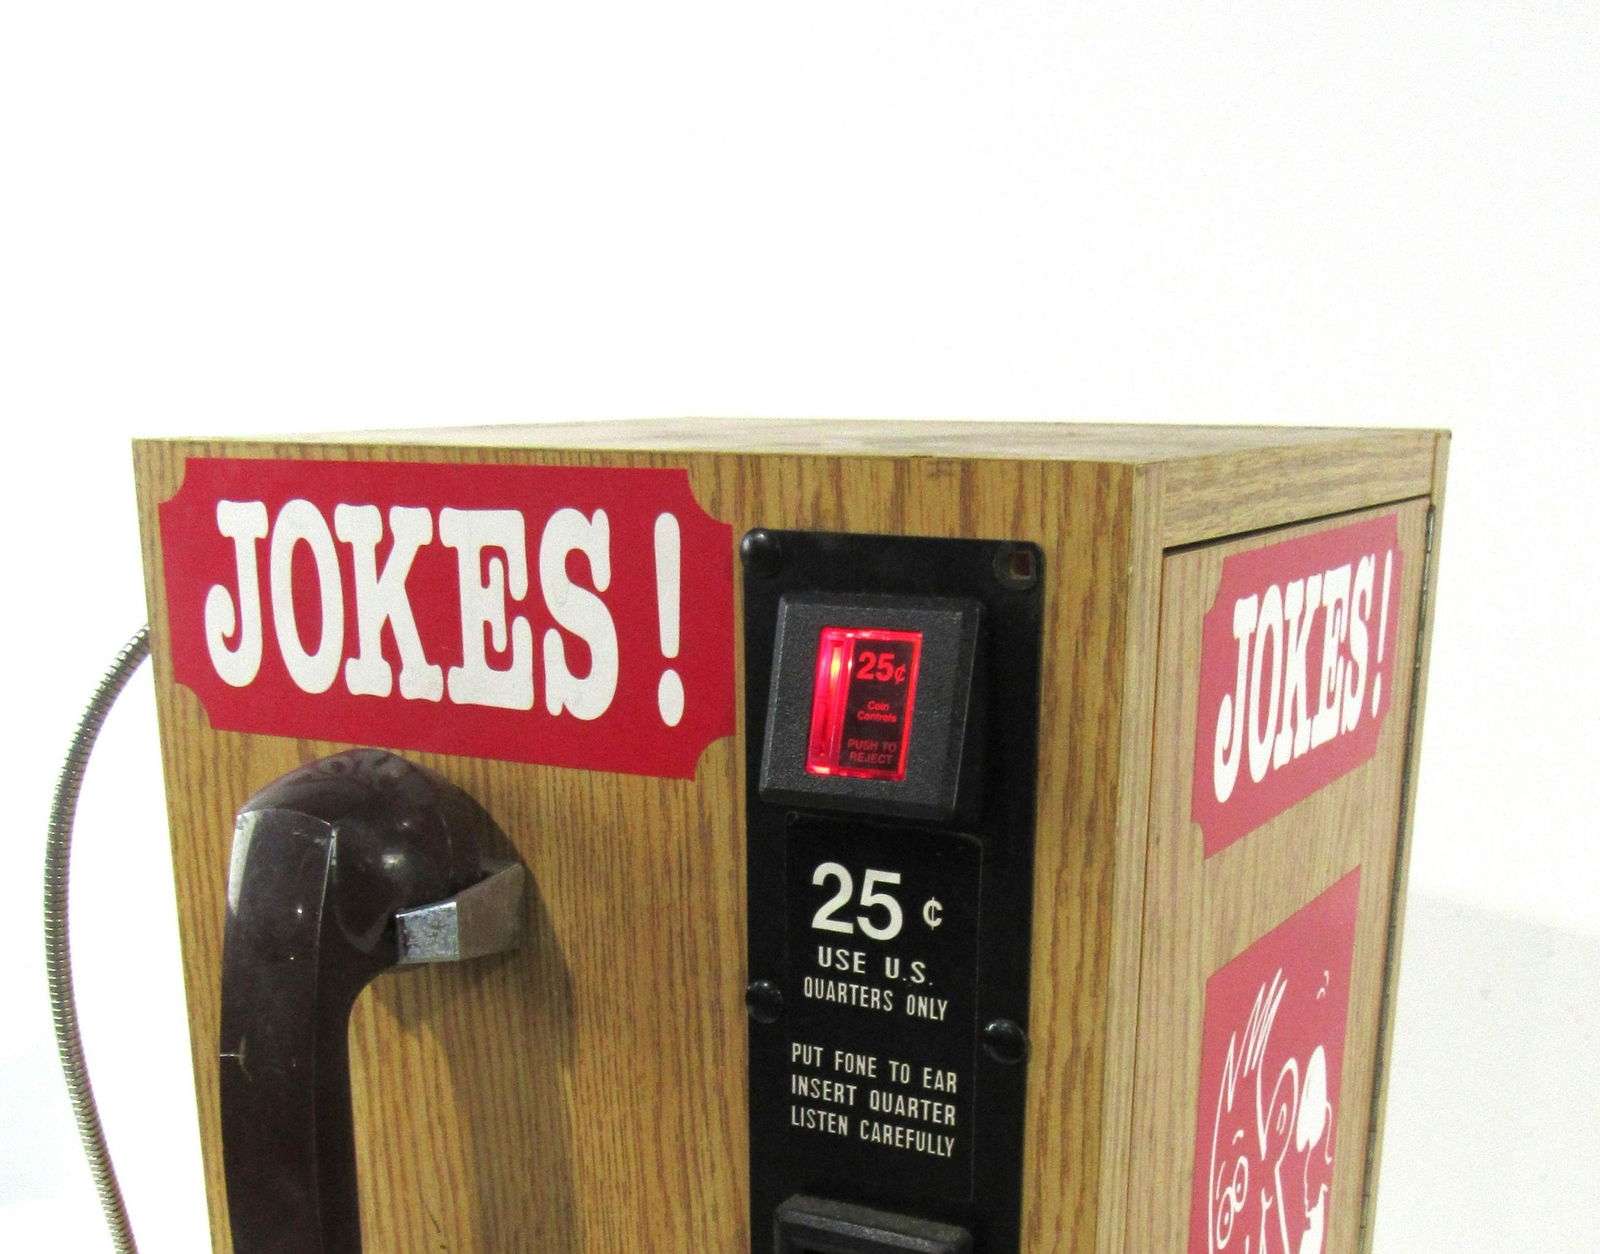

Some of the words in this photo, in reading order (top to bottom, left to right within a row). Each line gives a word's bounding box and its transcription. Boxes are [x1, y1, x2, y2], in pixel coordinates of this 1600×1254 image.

[856, 651, 906, 684] 25¢
[1213, 549, 1393, 804] JOKES!
[857, 711, 897, 722] Controls
[867, 700, 890, 711] Coin
[847, 738, 878, 752] PUSH
[882, 741, 897, 753] TO
[849, 751, 893, 764] REJECT
[811, 861, 903, 941] 25
[818, 945, 866, 975] USE
[884, 956, 934, 986] U.S.
[804, 976, 893, 1012] QUARTERS
[906, 994, 948, 1022] ONLY
[792, 1042, 824, 1067] PUT
[834, 1050, 877, 1078] FONE
[889, 1060, 910, 1084] TO
[923, 1067, 957, 1094] EAR
[791, 1074, 857, 1106] INSERT
[869, 1090, 956, 1126] QUARTER
[791, 1105, 848, 1136] LISTEN
[860, 1119, 955, 1158] CAREFULLY
